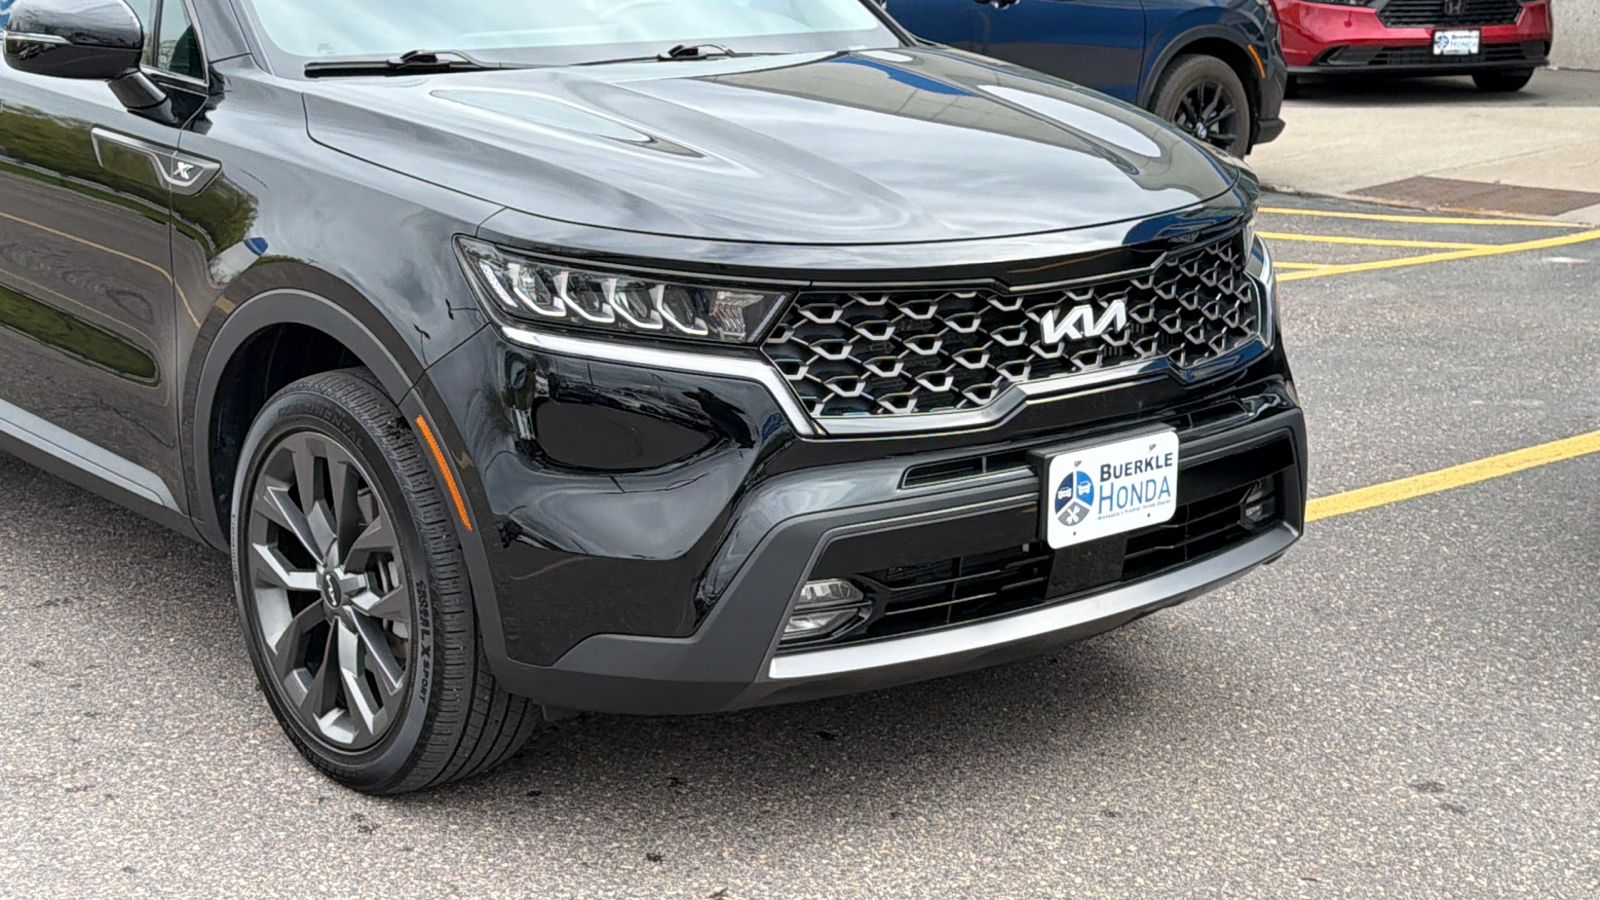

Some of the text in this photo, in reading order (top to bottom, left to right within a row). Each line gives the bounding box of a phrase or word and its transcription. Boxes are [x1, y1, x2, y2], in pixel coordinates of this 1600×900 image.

[1041, 299, 1127, 345] KIA
[1100, 452, 1174, 483] BUERKLE
[1098, 475, 1171, 515] HONDA
[419, 660, 431, 705] SPORT
